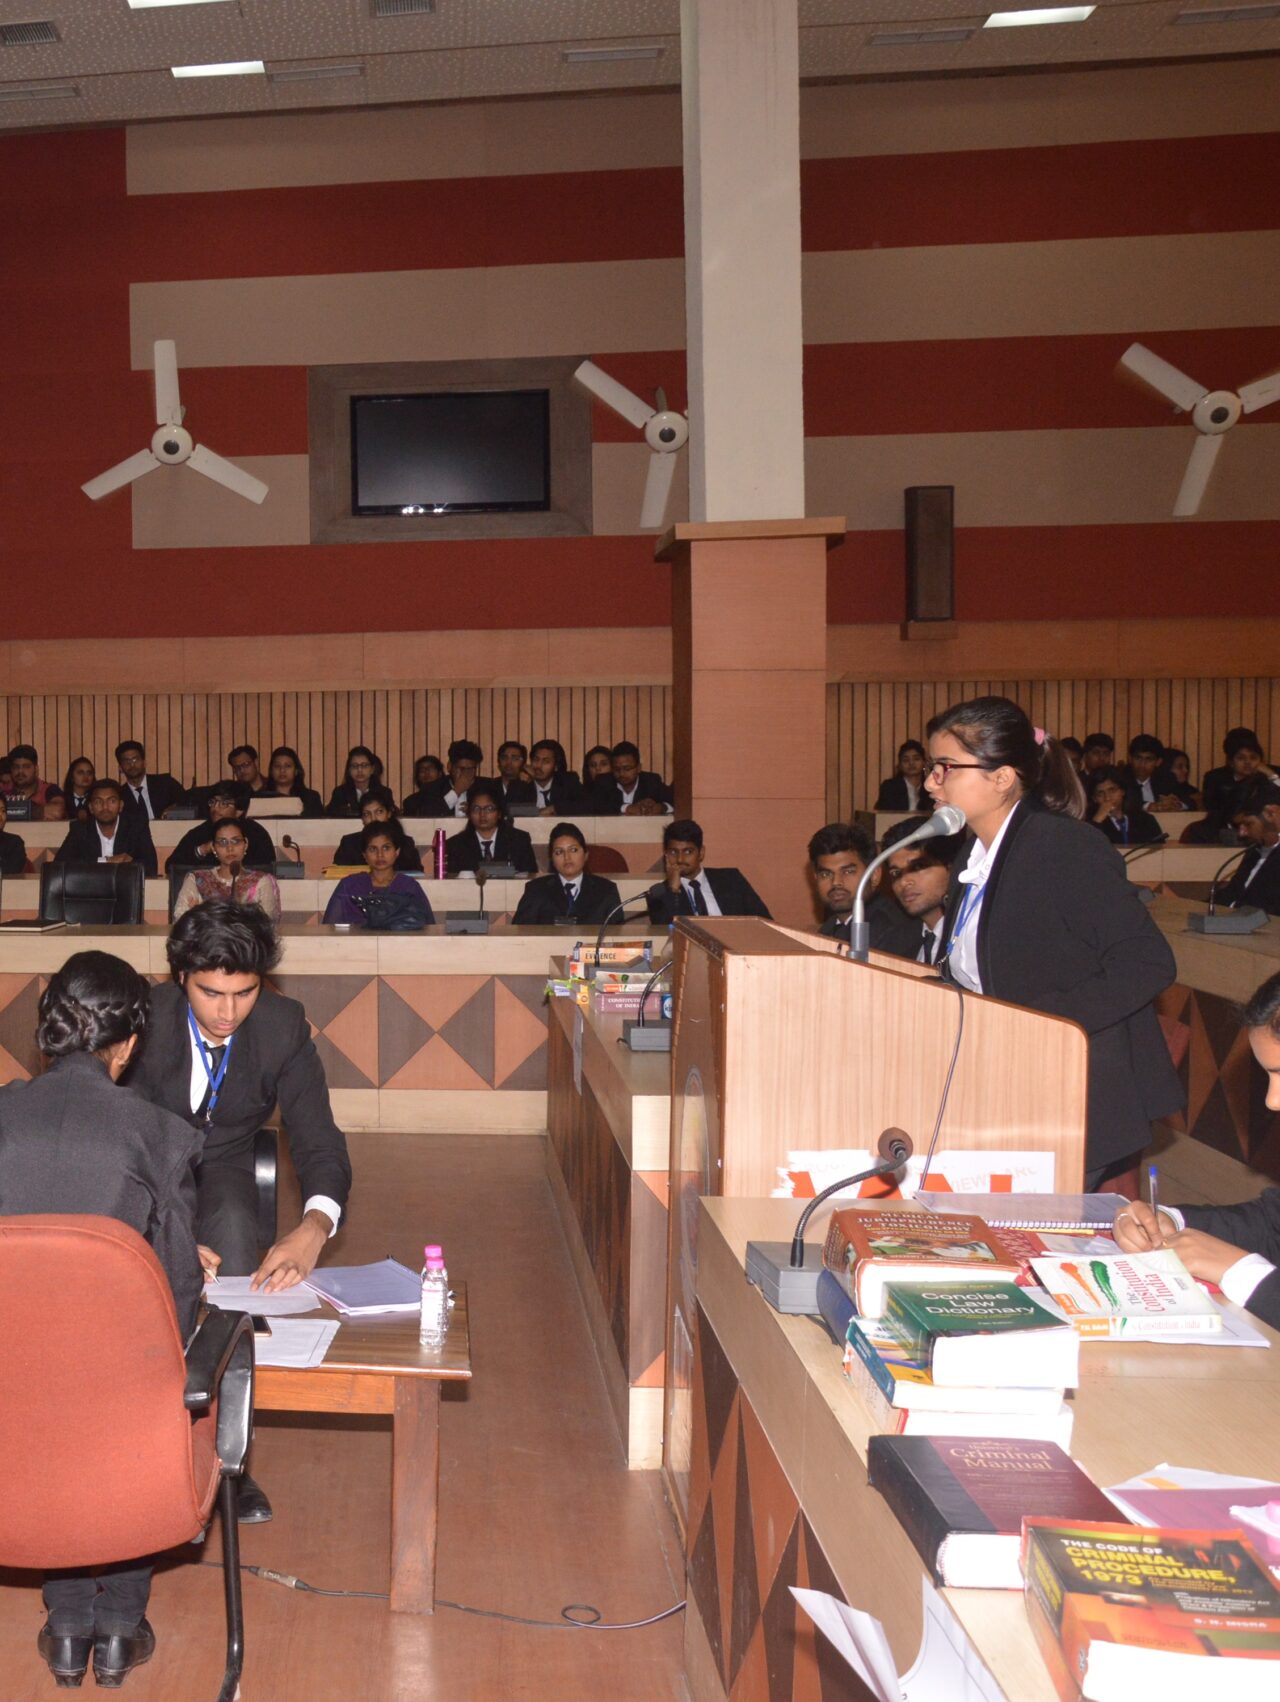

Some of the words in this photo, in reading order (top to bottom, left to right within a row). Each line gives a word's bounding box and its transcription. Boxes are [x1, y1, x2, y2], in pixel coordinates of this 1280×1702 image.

[857, 1218, 974, 1227] JURISPRUDENCE
[879, 1222, 971, 1231] TOXICOLOGY
[1113, 1260, 1165, 1313] Constitution
[1145, 1273, 1176, 1301] India
[921, 1292, 1009, 1301] Concise
[1126, 1292, 1142, 1305] The
[925, 1305, 1035, 1314] Dictionary
[950, 1300, 995, 1308] Law
[949, 1447, 1051, 1460] Criminal
[963, 1458, 1053, 1470] Manual
[1060, 1539, 1092, 1550] THE
[1095, 1542, 1139, 1553] CODE
[1142, 1546, 1163, 1555] OF
[1065, 1546, 1185, 1568] CRIMINAL
[1071, 1557, 1237, 1584] PROCEDURE,
[1080, 1569, 1143, 1587] 1973
